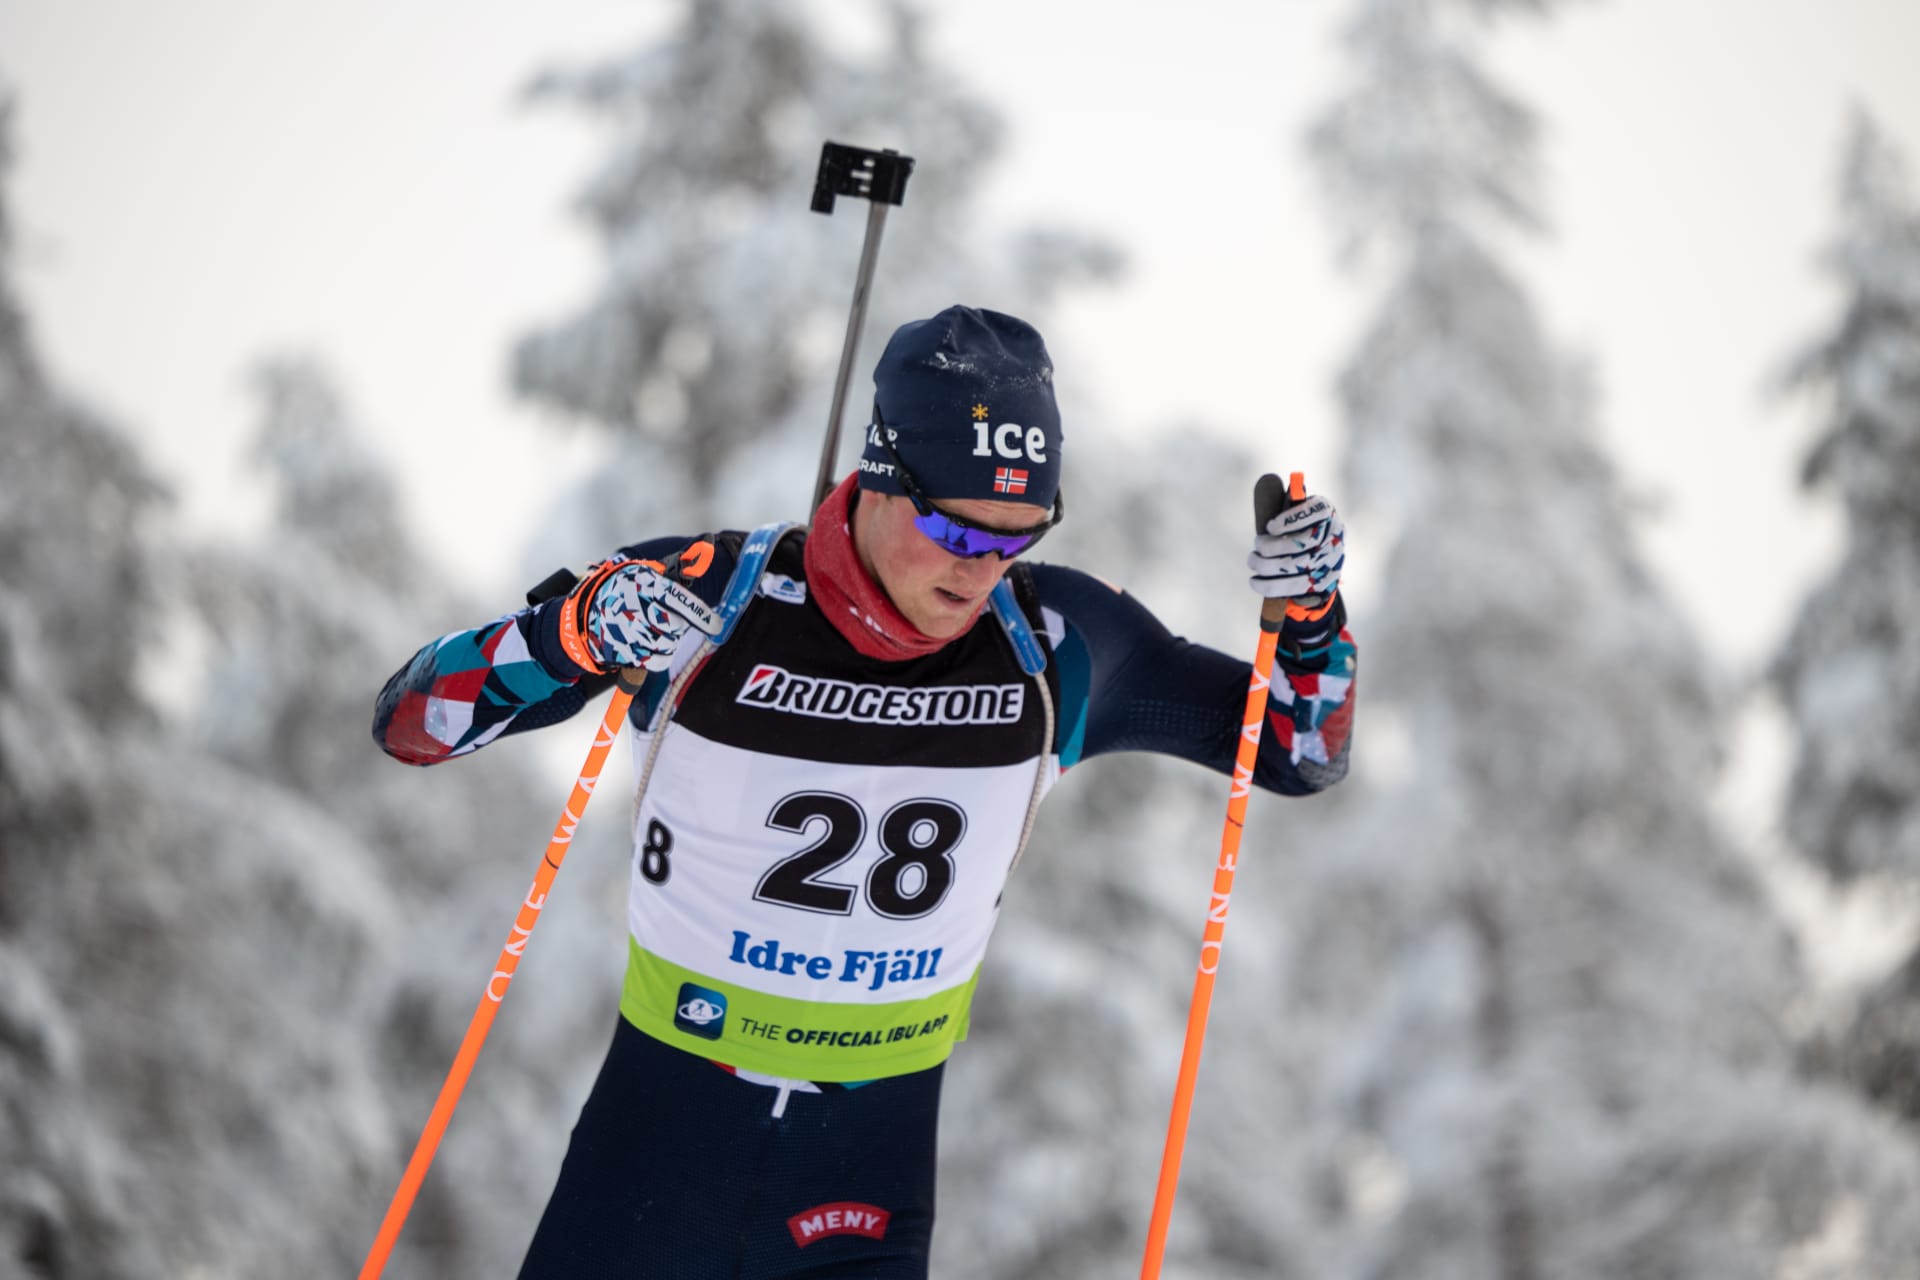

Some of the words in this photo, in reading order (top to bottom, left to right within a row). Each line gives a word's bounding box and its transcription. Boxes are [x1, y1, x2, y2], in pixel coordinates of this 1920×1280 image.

[972, 421, 1048, 464] ice
[1283, 501, 1327, 527] AUCLAIR
[663, 585, 705, 618] AUCLAIR
[735, 663, 1025, 727] BRIDGESTONE
[751, 790, 969, 921] 28
[729, 930, 833, 981] Idre
[838, 946, 944, 992] Fjäll
[740, 1017, 783, 1041] THE
[785, 1028, 883, 1048] OFFICIAL
[885, 1023, 920, 1044] IBU
[918, 1013, 950, 1037] APP
[799, 1210, 881, 1238] MENY
